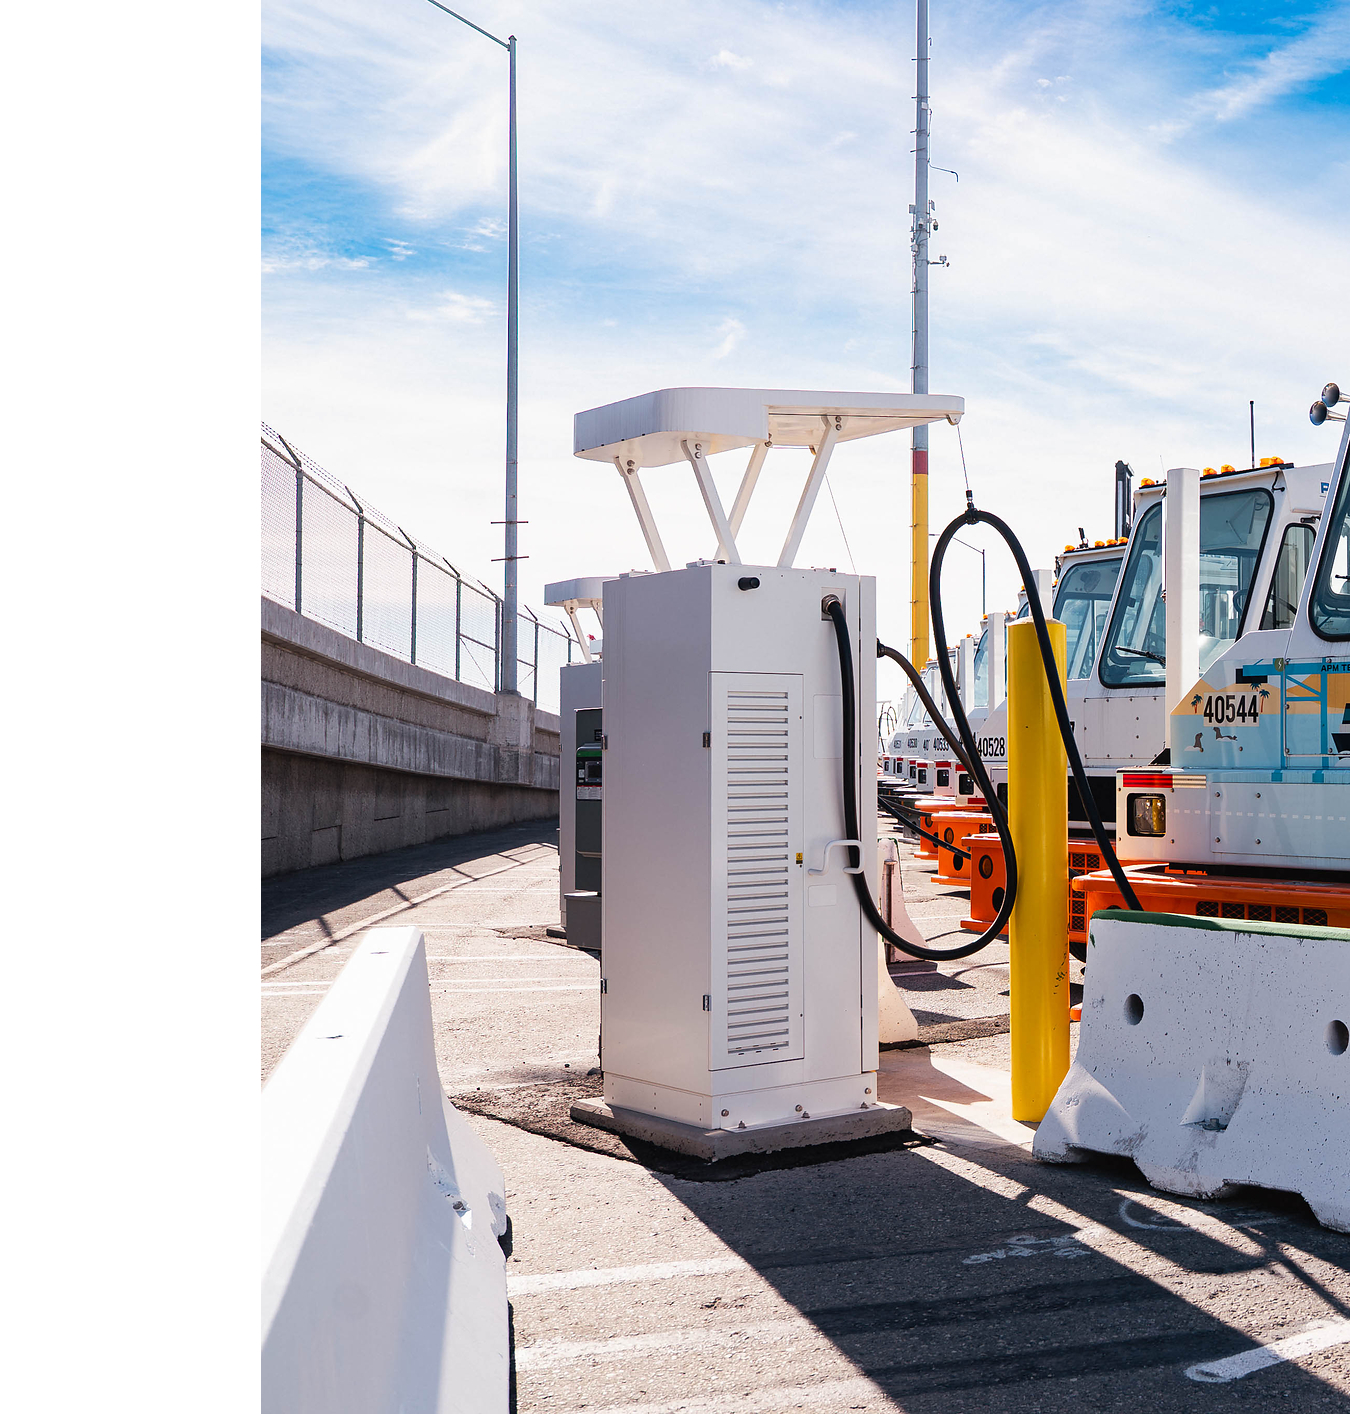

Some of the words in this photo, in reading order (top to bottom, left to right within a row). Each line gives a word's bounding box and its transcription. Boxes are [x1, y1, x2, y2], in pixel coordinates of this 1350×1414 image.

[1320, 664, 1339, 672] APM
[1203, 695, 1259, 724] 40544
[977, 737, 1005, 756] 40528
